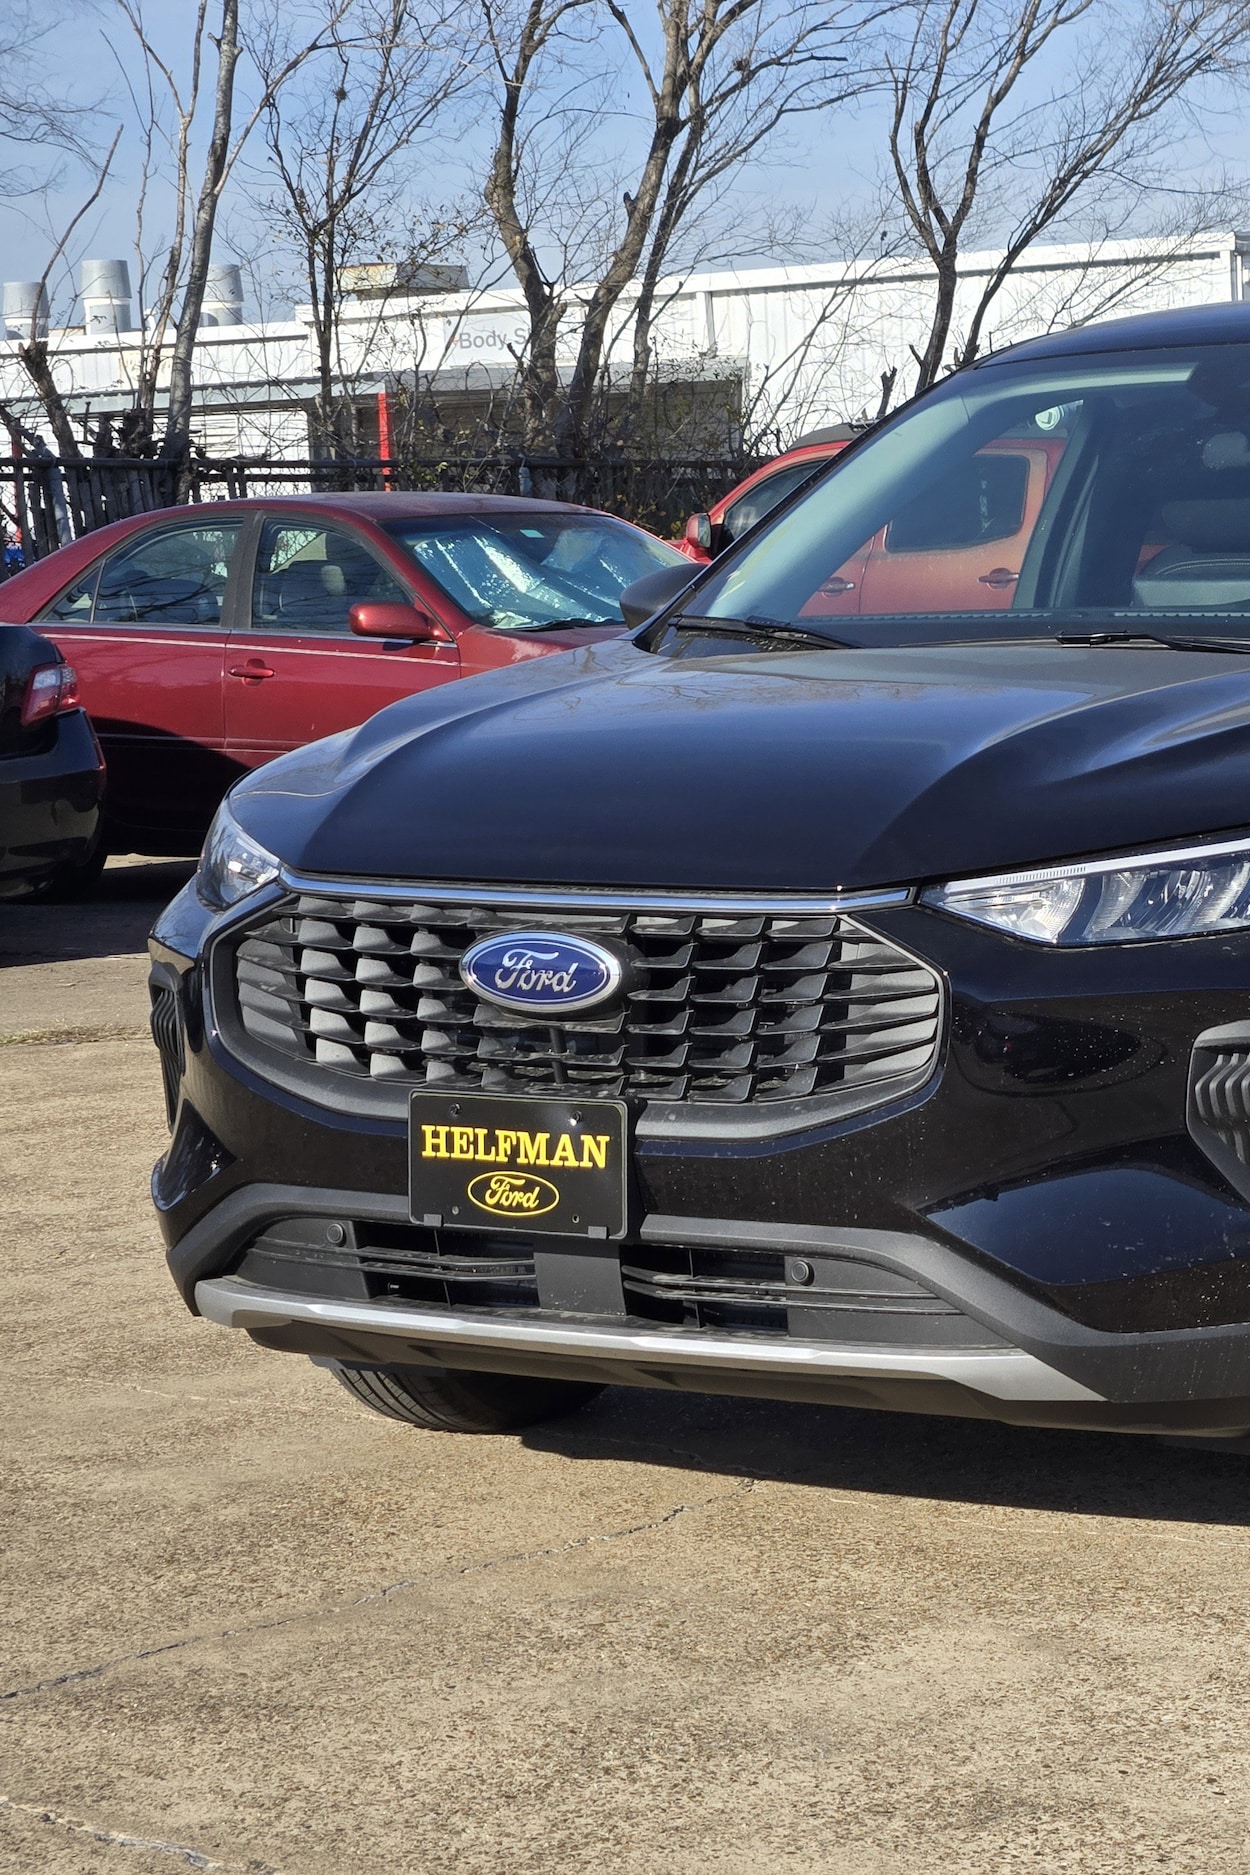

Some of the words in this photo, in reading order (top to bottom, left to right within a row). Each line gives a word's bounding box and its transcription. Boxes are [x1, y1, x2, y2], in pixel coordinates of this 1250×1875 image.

[459, 330, 507, 350] Body
[494, 949, 579, 993] Ford
[421, 1124, 610, 1169] HELFMAN
[485, 1175, 540, 1209] Ford
